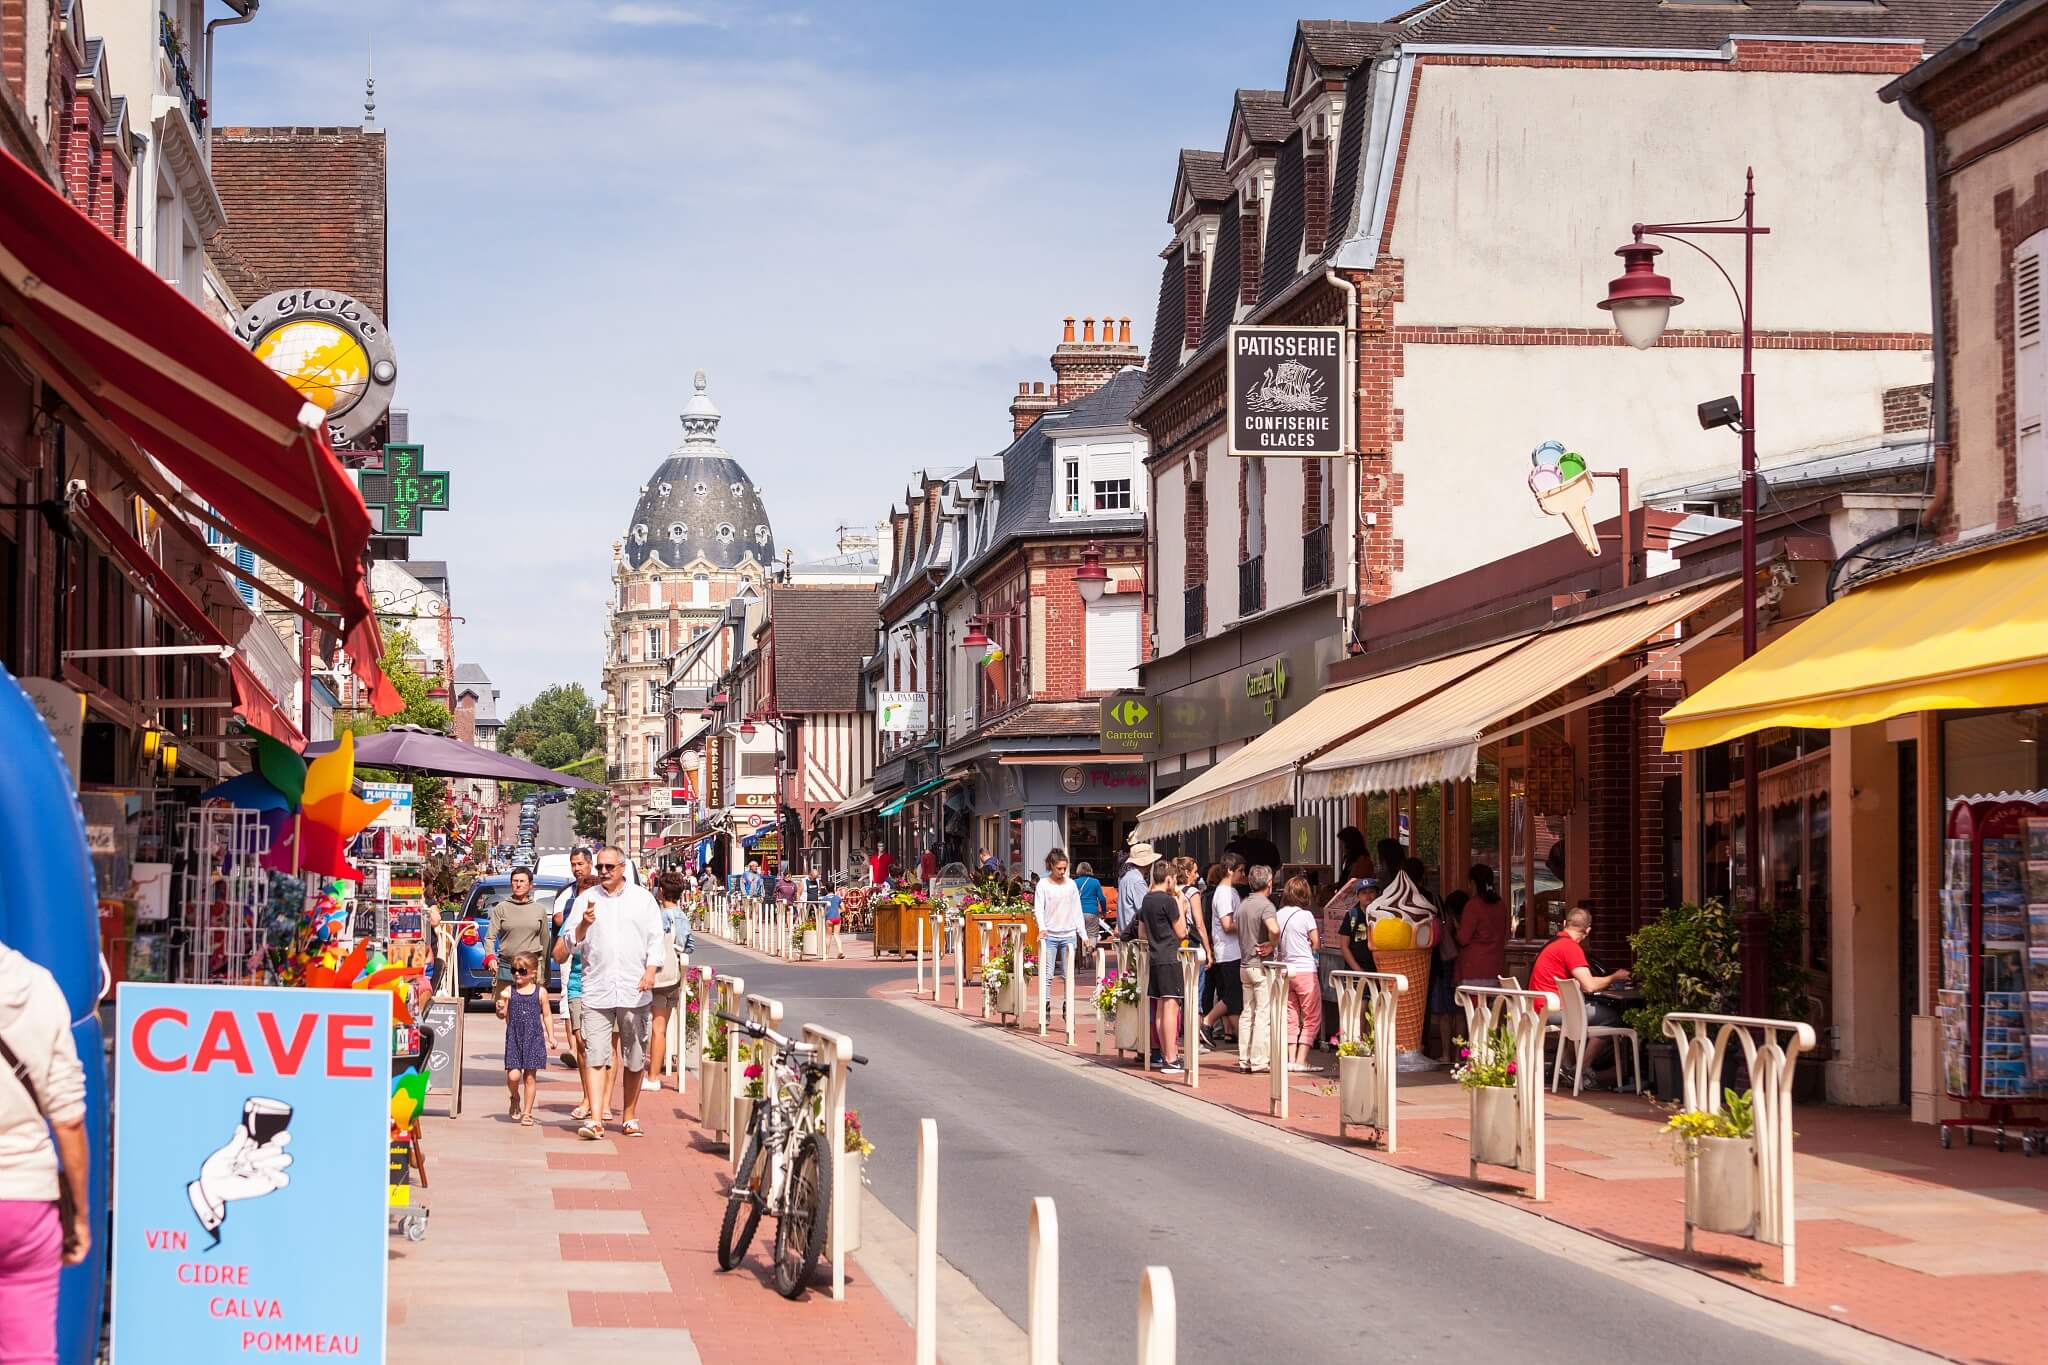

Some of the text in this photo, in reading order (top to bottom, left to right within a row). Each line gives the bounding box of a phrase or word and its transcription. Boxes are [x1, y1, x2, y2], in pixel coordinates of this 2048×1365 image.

[234, 290, 377, 342] le globe
[1238, 336, 1336, 356] PATISSERIE
[1245, 416, 1329, 430] CONFISERIE
[1260, 433, 1315, 447] GLACES
[1246, 667, 1273, 697] Carrefour
[882, 693, 926, 702] LA PAMPA
[1106, 730, 1154, 740] Carrefour
[1121, 739, 1139, 750] city
[355, 914, 374, 929] ARIS
[131, 1008, 374, 1079] CAVE
[145, 1230, 187, 1250] VIN
[177, 1264, 249, 1285] CIDRE
[210, 1297, 283, 1319] CALVA
[242, 1331, 359, 1355] POMMEAU
